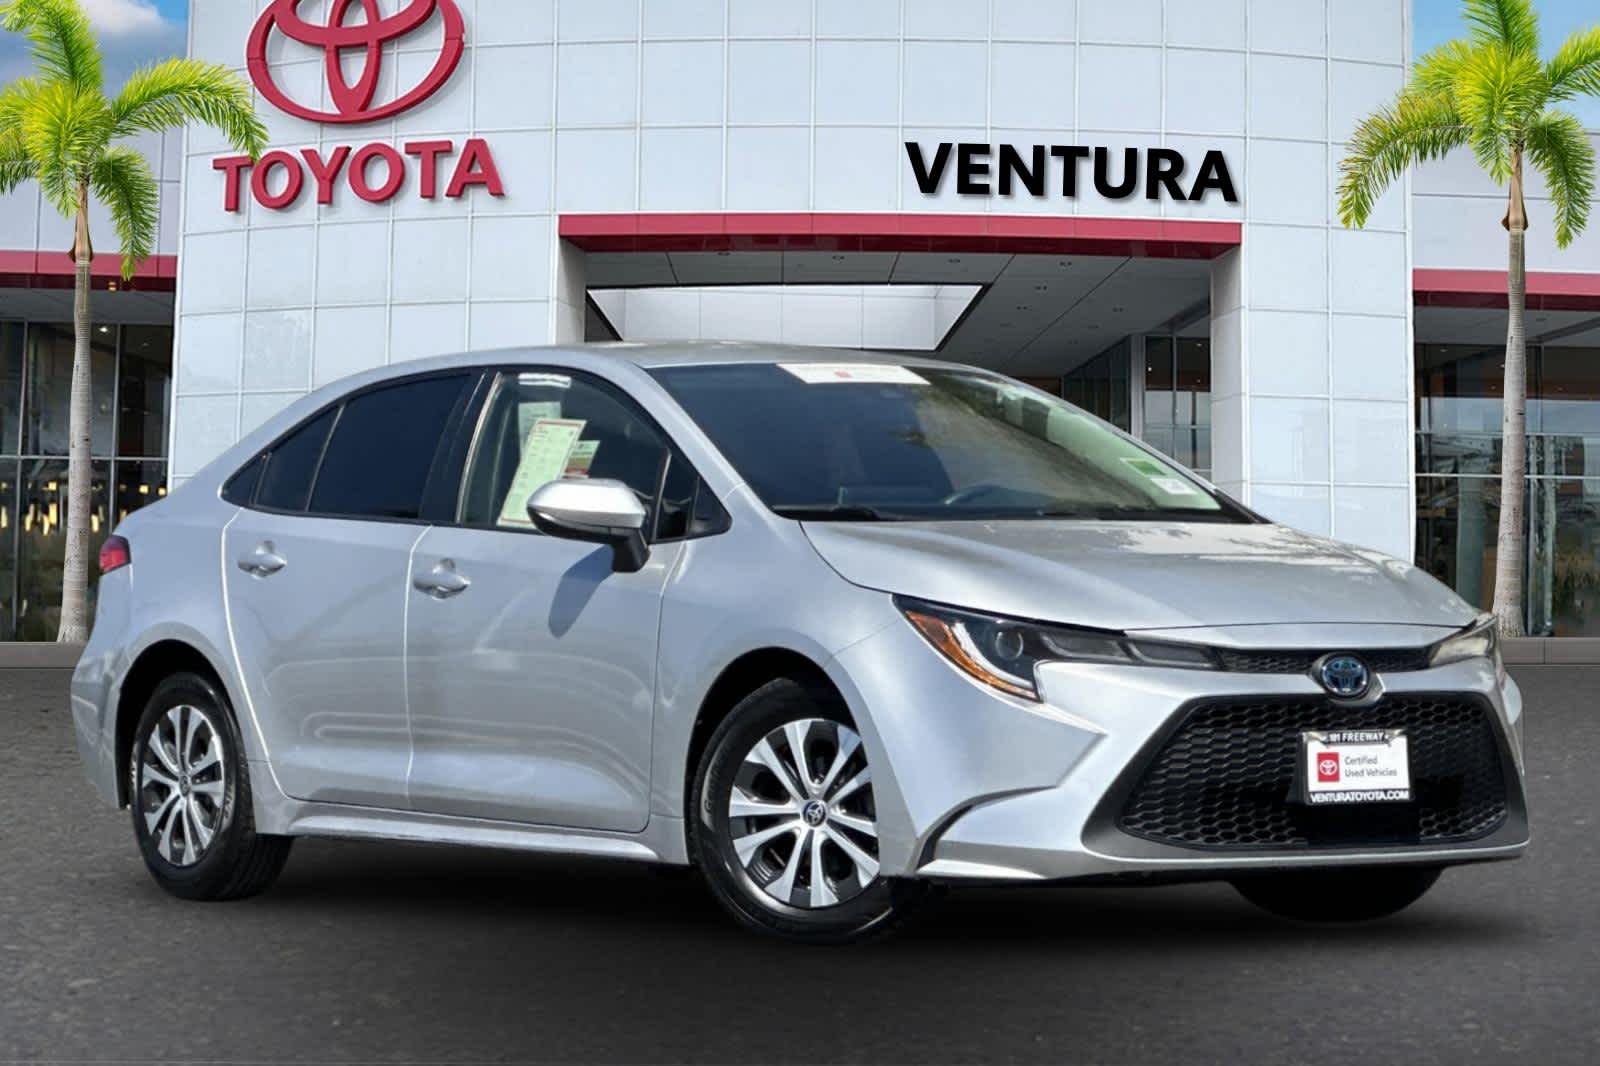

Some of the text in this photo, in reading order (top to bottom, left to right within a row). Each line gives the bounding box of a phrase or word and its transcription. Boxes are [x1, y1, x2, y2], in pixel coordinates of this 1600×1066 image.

[213, 139, 505, 212] TOYOTA
[904, 142, 1239, 203] VENTURA
[1342, 732, 1384, 743] FREEWAY
[1344, 755, 1378, 765] Certified
[1344, 767, 1398, 777] Used Vehicles
[1310, 790, 1410, 803] VENTURATOYOTA.COM
